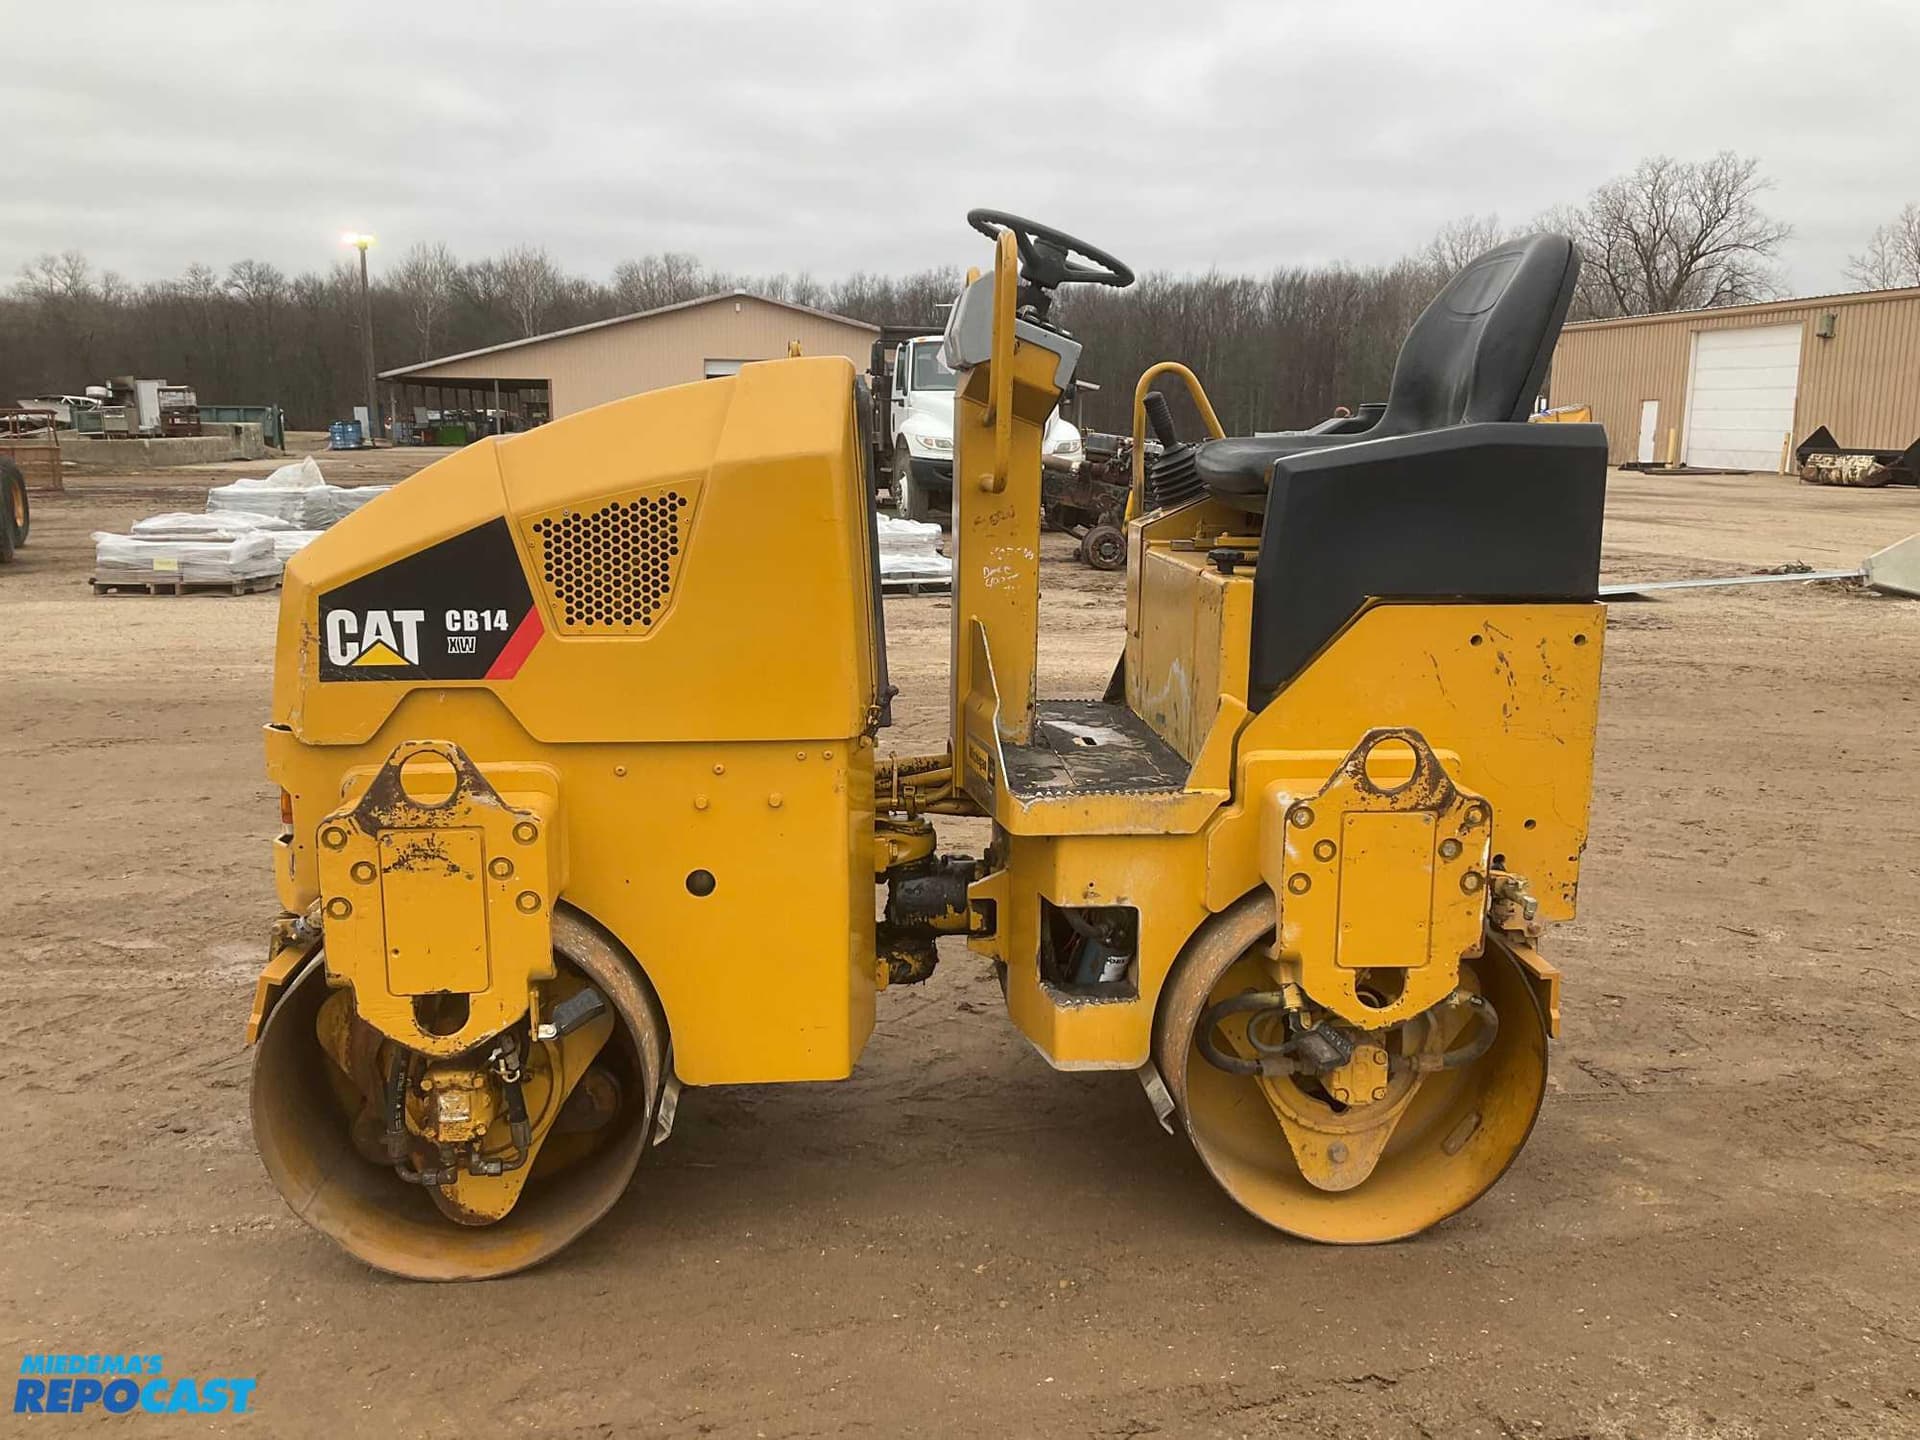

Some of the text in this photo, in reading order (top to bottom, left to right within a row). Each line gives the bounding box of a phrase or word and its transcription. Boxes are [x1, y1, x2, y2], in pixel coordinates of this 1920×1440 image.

[326, 609, 509, 666] CAT CB14
[447, 636, 476, 654] XW
